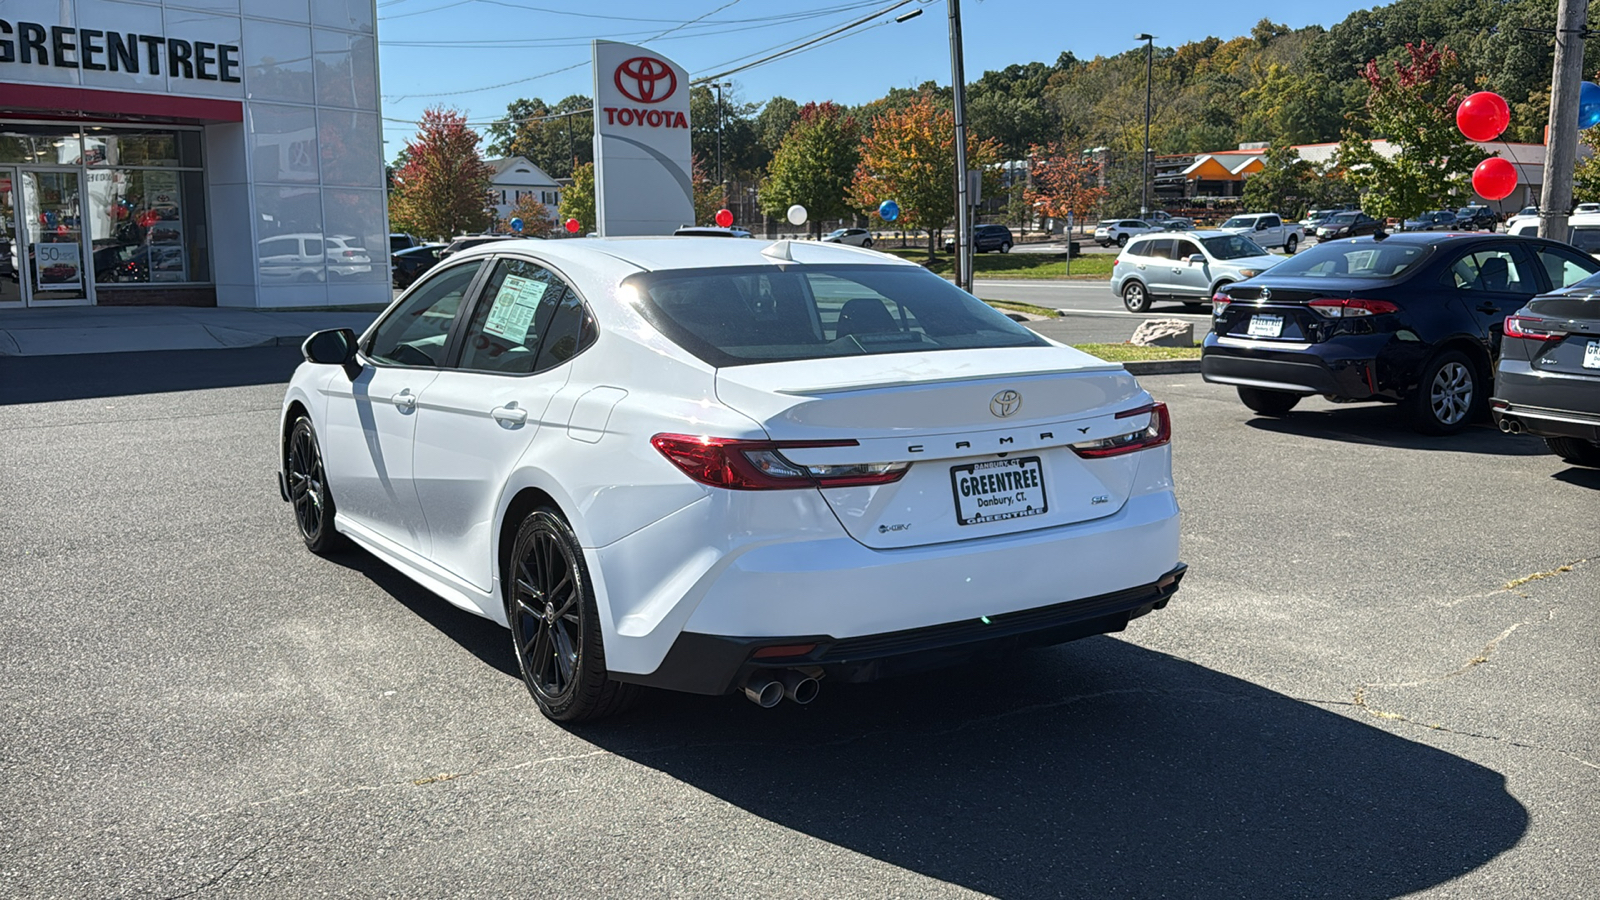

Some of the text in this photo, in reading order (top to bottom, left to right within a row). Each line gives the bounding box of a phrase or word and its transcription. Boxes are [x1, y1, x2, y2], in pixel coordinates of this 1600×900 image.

[603, 107, 688, 128] TOYOTA
[908, 427, 1090, 453] CAMRY
[960, 468, 1039, 497] GREENTREE
[977, 492, 1027, 508] Danbury, CT.
[966, 508, 1045, 525] GREENTREE
